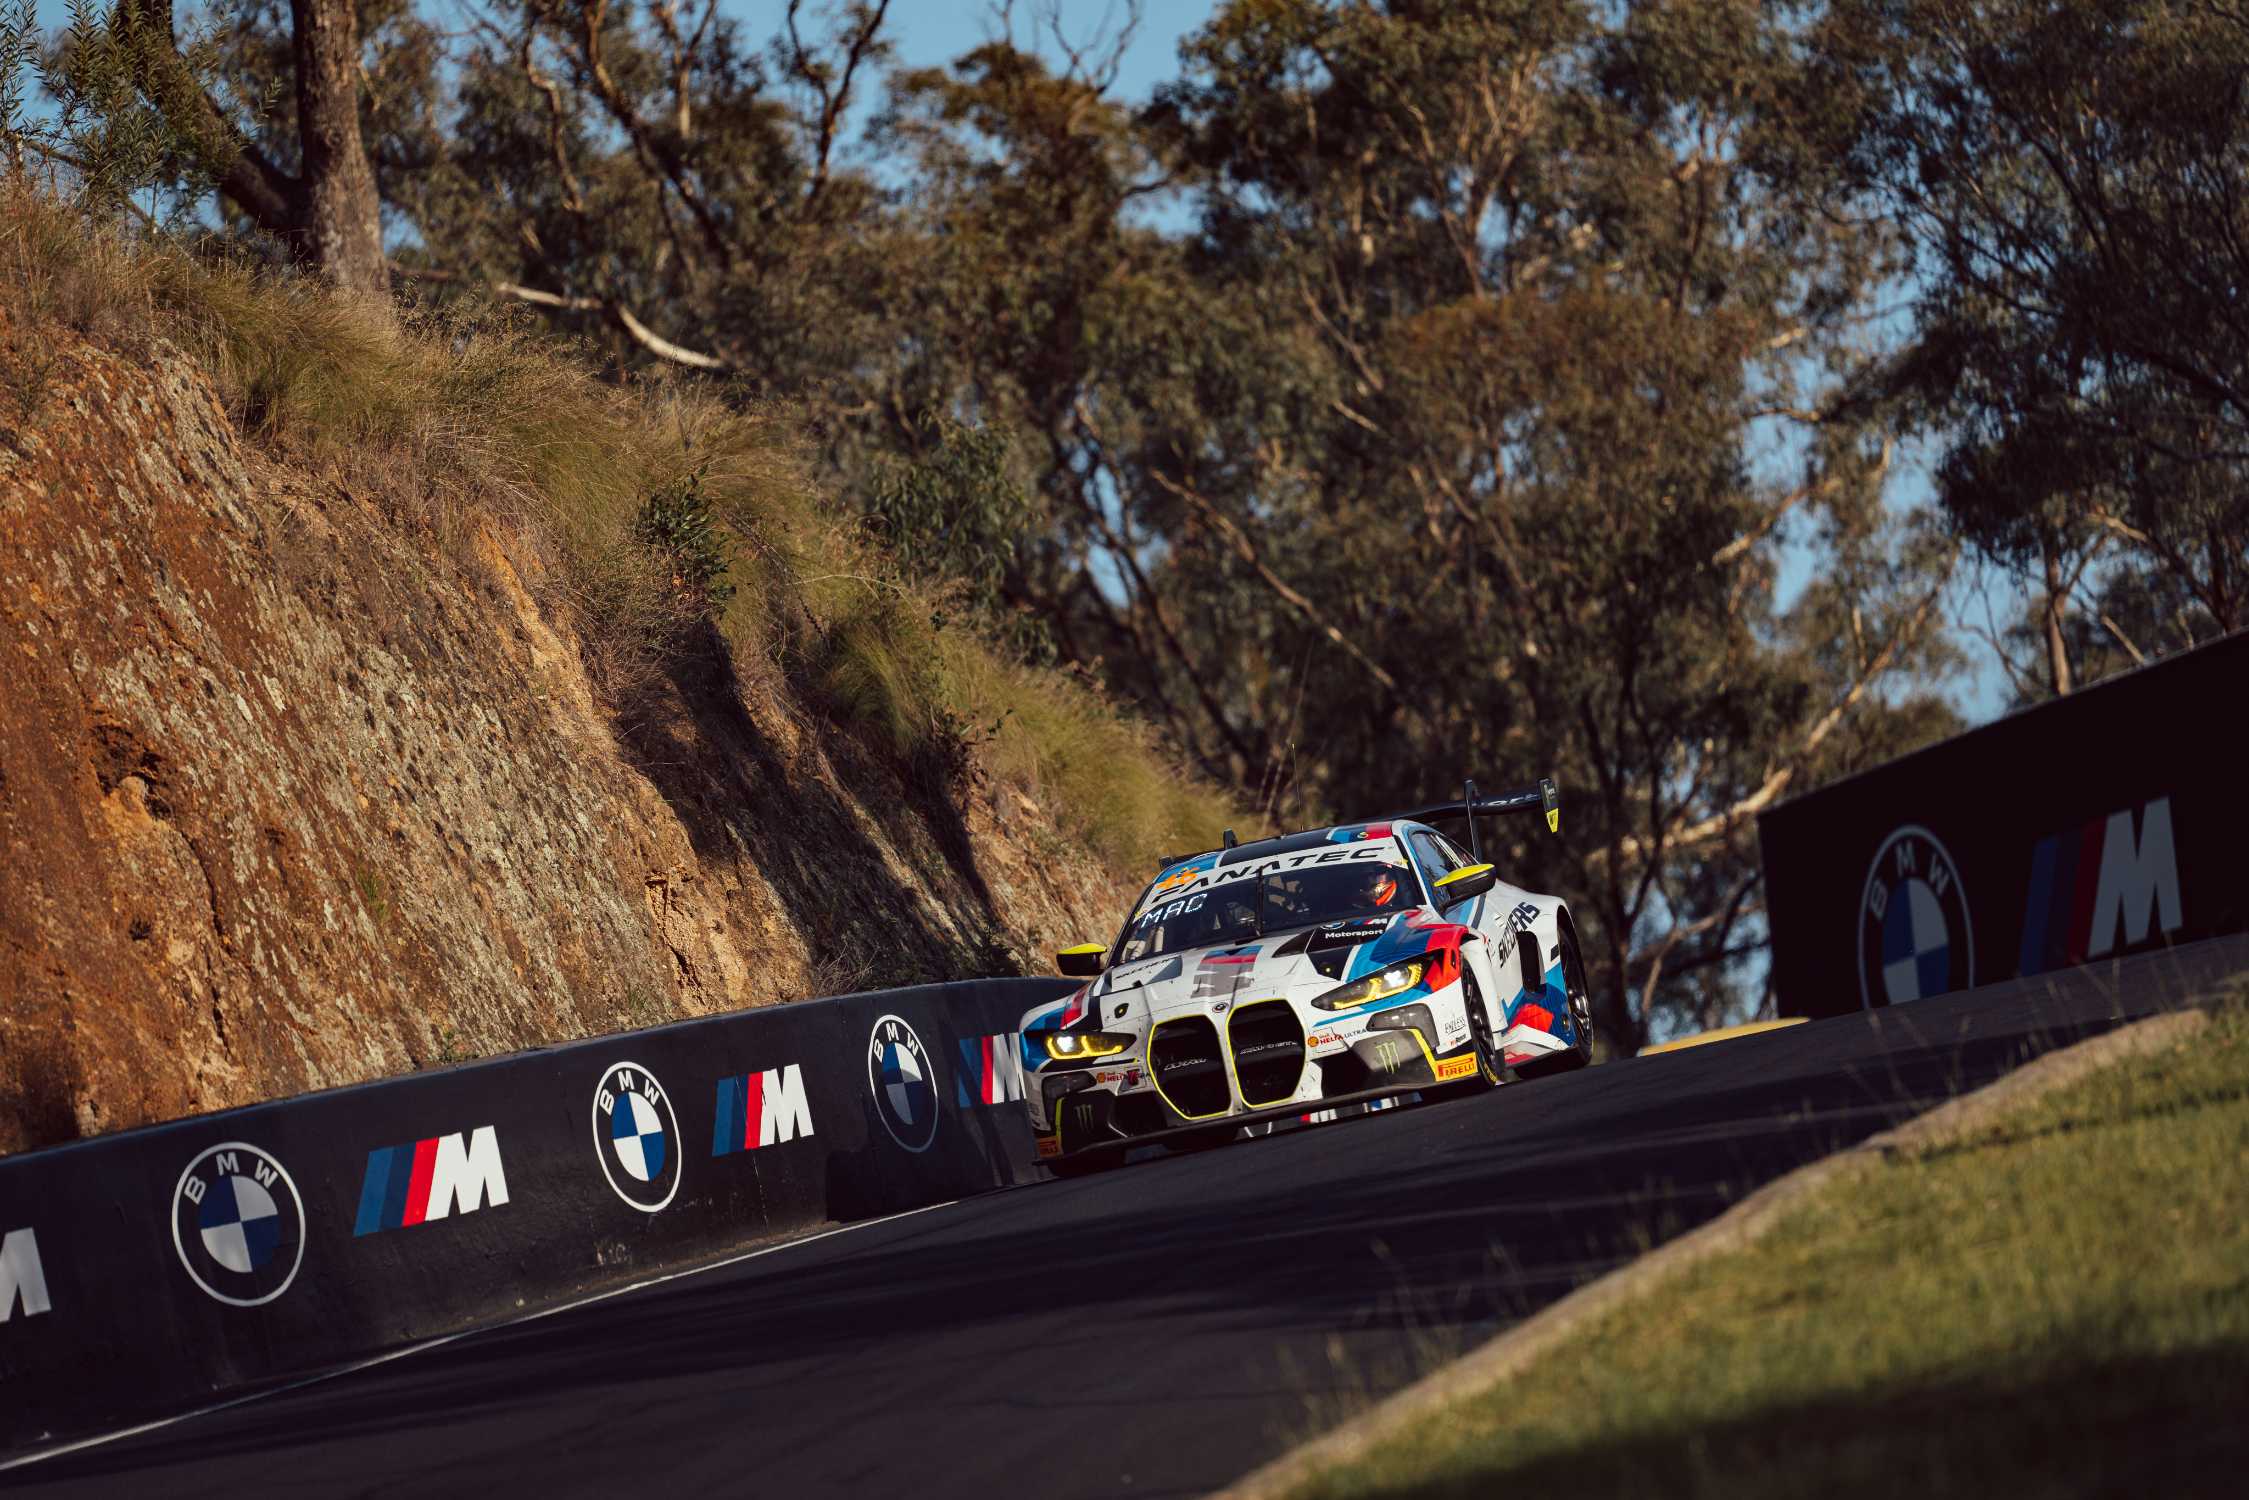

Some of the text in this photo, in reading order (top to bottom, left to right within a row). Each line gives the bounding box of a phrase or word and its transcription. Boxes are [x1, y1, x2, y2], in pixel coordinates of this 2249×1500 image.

[1151, 847, 1385, 904] FANATEC
[1869, 840, 1949, 921] BMW
[1140, 893, 1208, 929] MAC
[1325, 929, 1384, 939] Motorsport
[873, 1022, 919, 1063] BMW
[1437, 1057, 1475, 1077] PIRELLI
[599, 1070, 660, 1117] BMW
[760, 1063, 815, 1147] M
[183, 1151, 278, 1205] BMW
[424, 1125, 510, 1222] M
